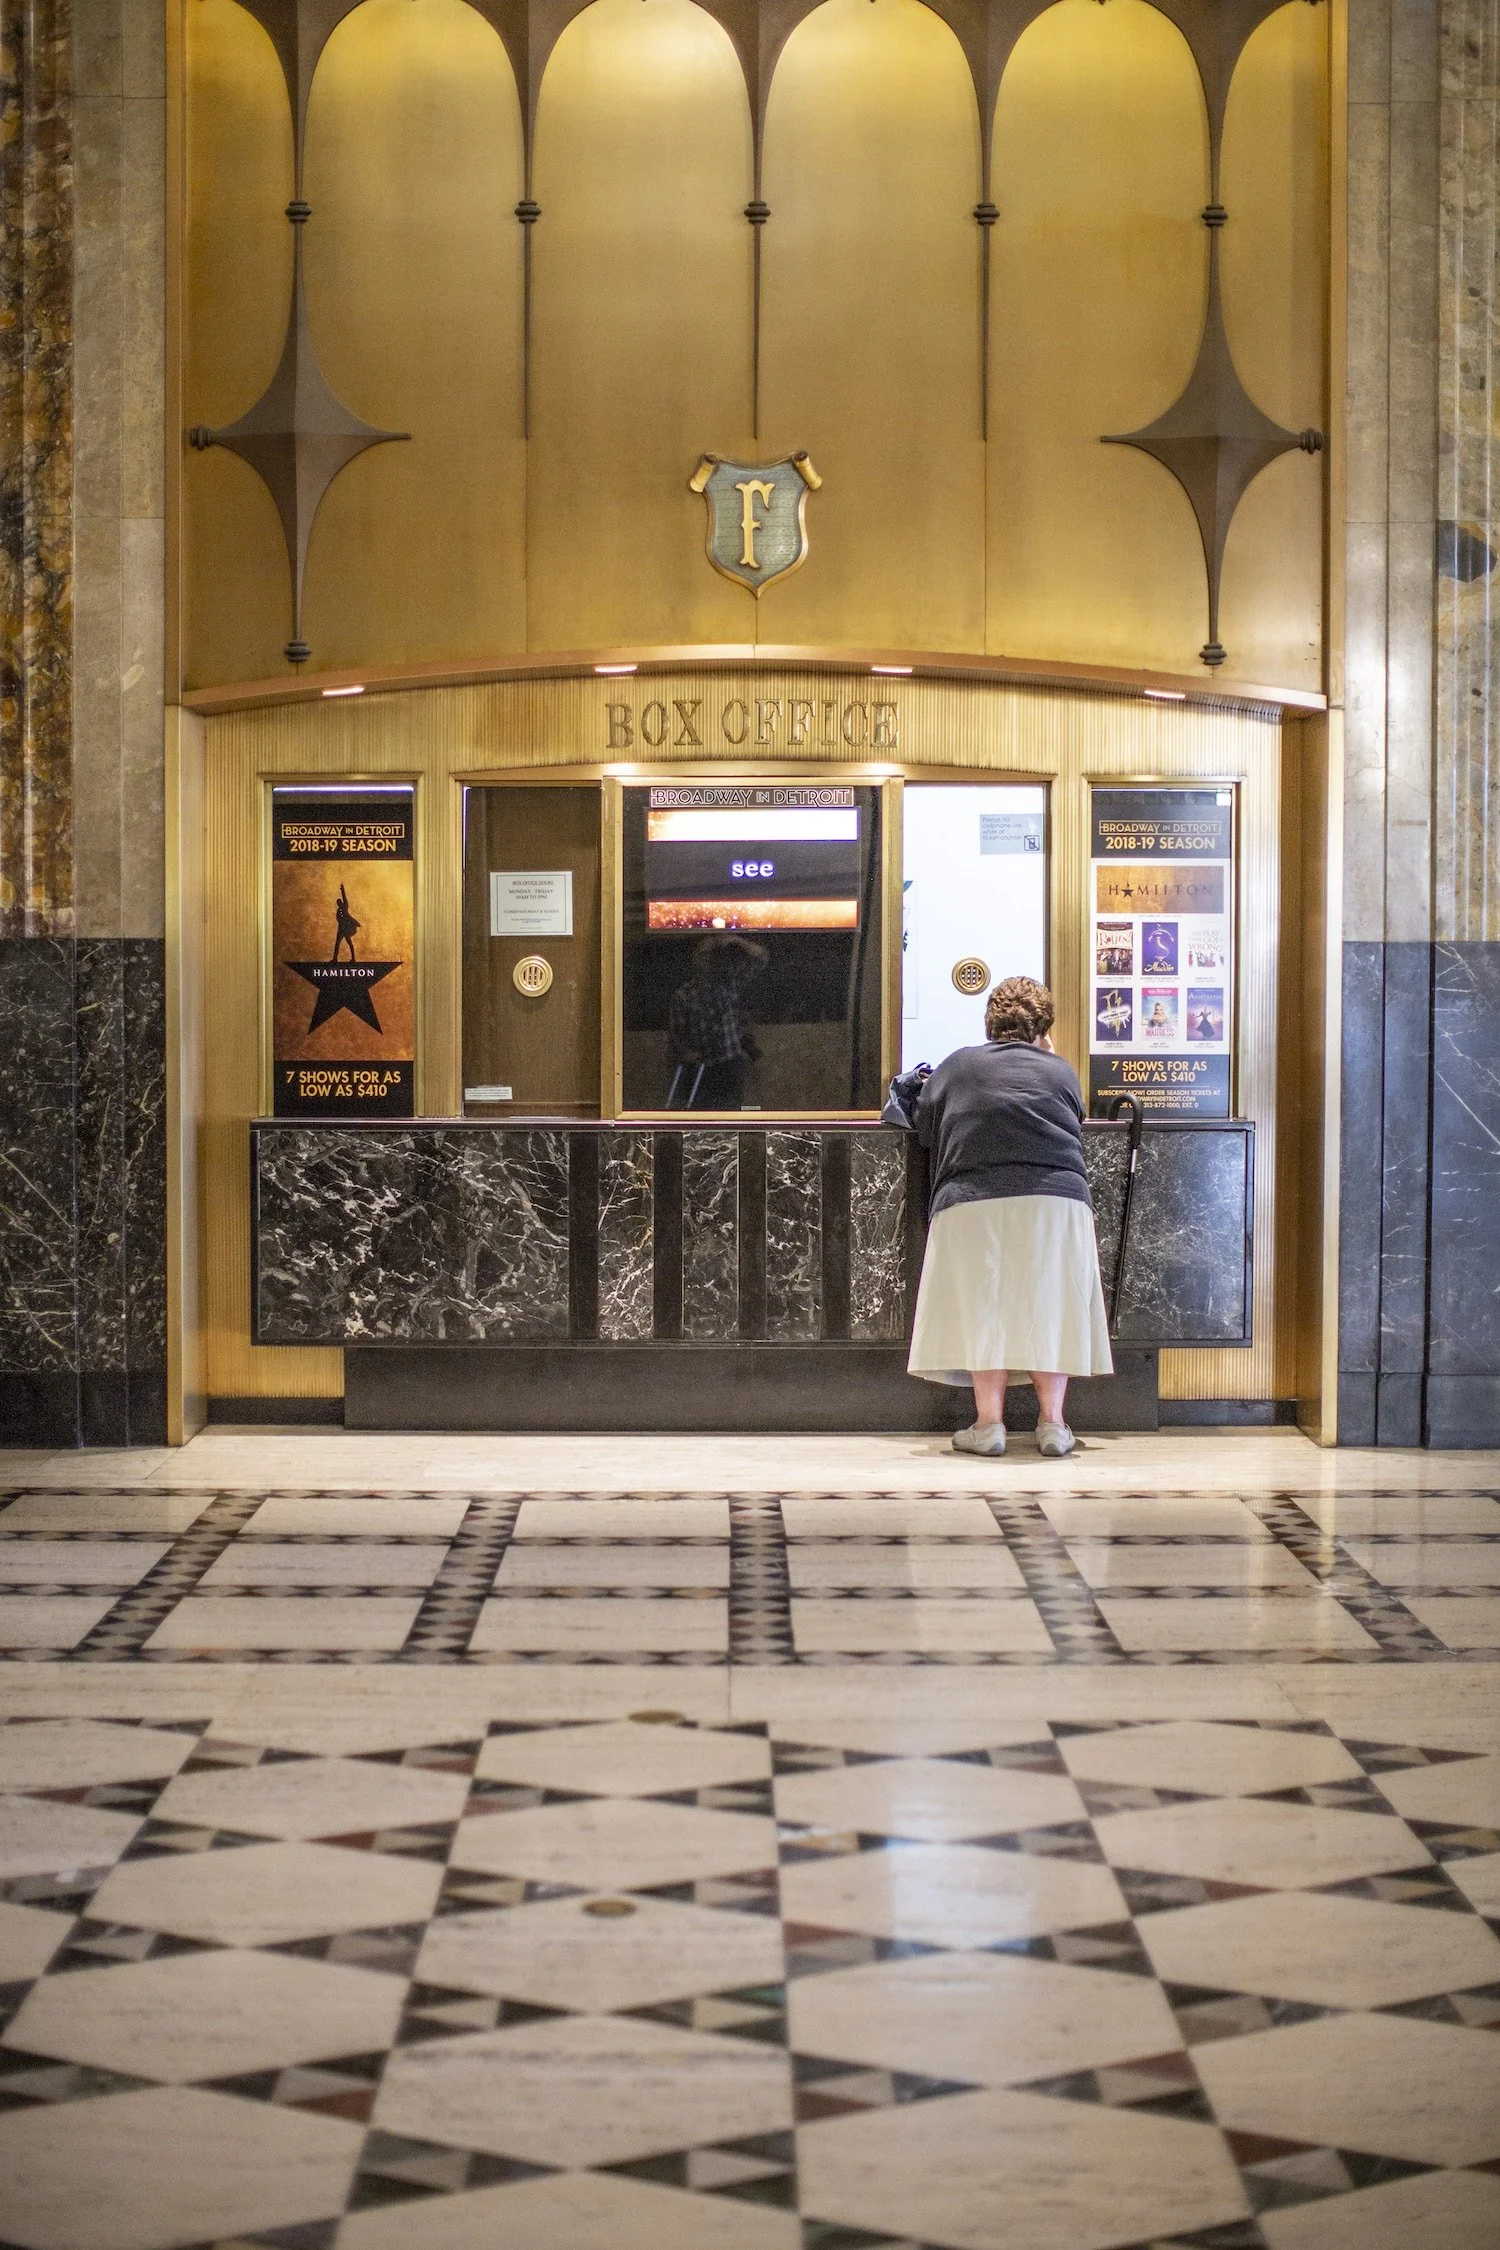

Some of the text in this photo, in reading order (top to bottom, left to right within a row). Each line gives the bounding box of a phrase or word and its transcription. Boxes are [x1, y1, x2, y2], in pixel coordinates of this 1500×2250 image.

[605, 698, 899, 749] BOX OFFICE
[653, 789, 850, 805] BROADWAY IN DETROIT
[284, 826, 342, 836] BROADWAY
[355, 826, 401, 836] DETROIT
[1102, 823, 1160, 833] BROADWAY
[1172, 823, 1218, 833] DETROIT
[289, 839, 397, 852] 2018-19 SEASON
[1105, 836, 1216, 850] 2018-19 SEASON
[731, 861, 775, 878] see
[313, 969, 375, 977] HAMILTON
[1112, 1061, 1207, 1071] 7 SHOWS FOR AS
[286, 1071, 401, 1083] 7 SHOWS FOR AS
[1123, 1071, 1196, 1083] LOW AS $410
[300, 1084, 388, 1098] LOW AS $410
